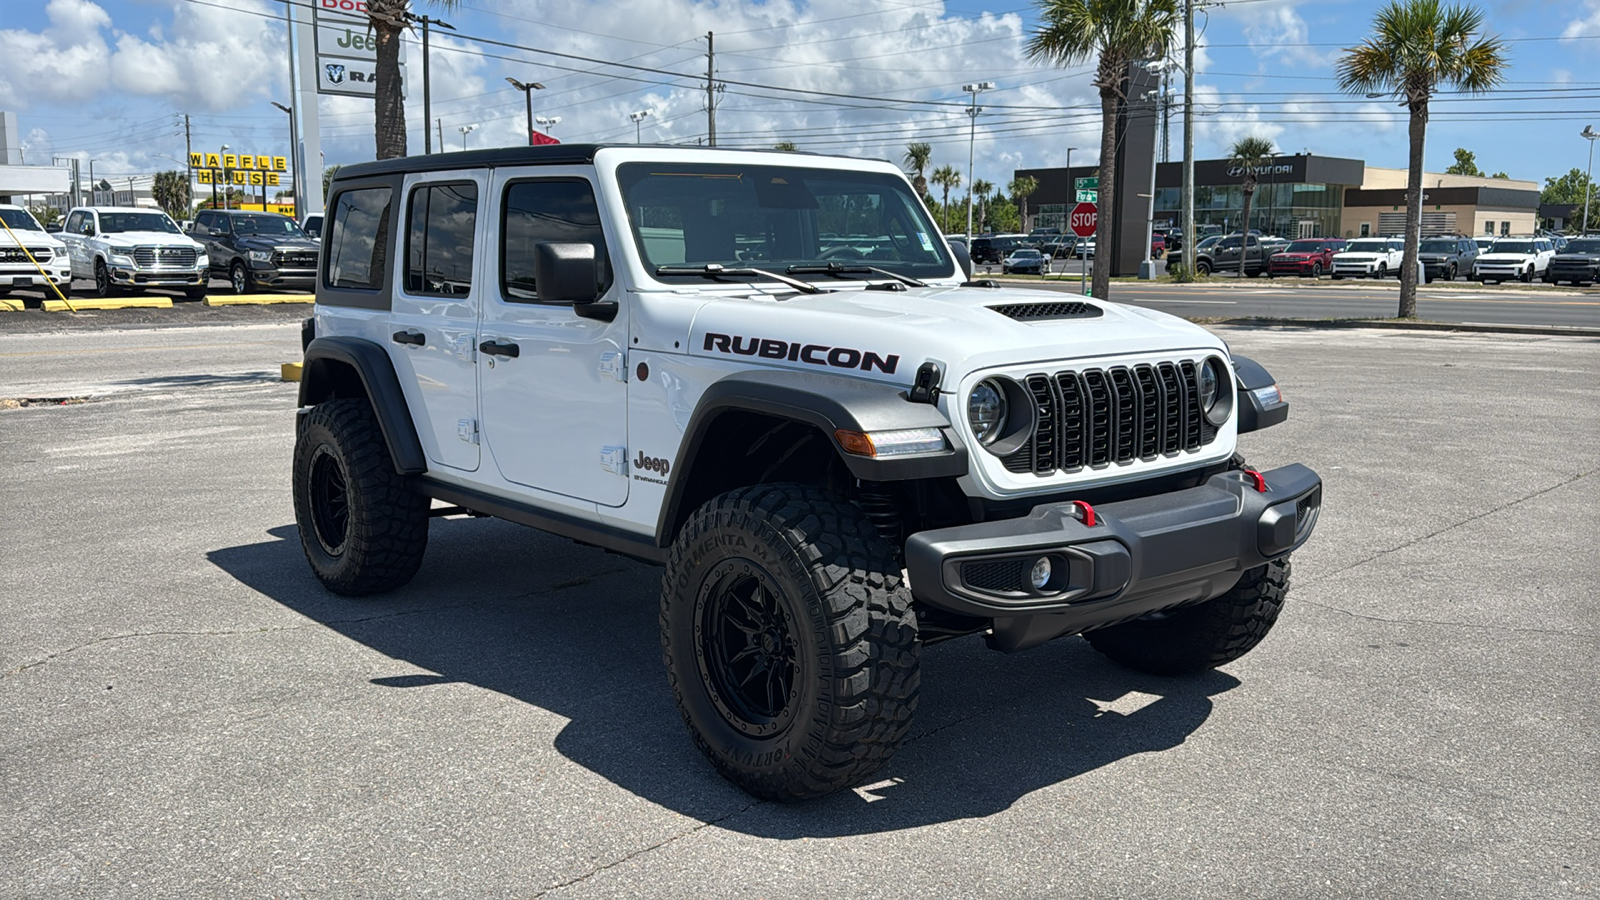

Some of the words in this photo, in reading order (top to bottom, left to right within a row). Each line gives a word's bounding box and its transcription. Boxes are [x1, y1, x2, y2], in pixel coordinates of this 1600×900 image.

[322, 0, 369, 13] DOD
[337, 29, 377, 51] Jee
[190, 154, 284, 169] WAFFLE
[1072, 213, 1097, 226] STOP
[703, 332, 900, 374] RUBICON
[633, 450, 670, 477] Jeep
